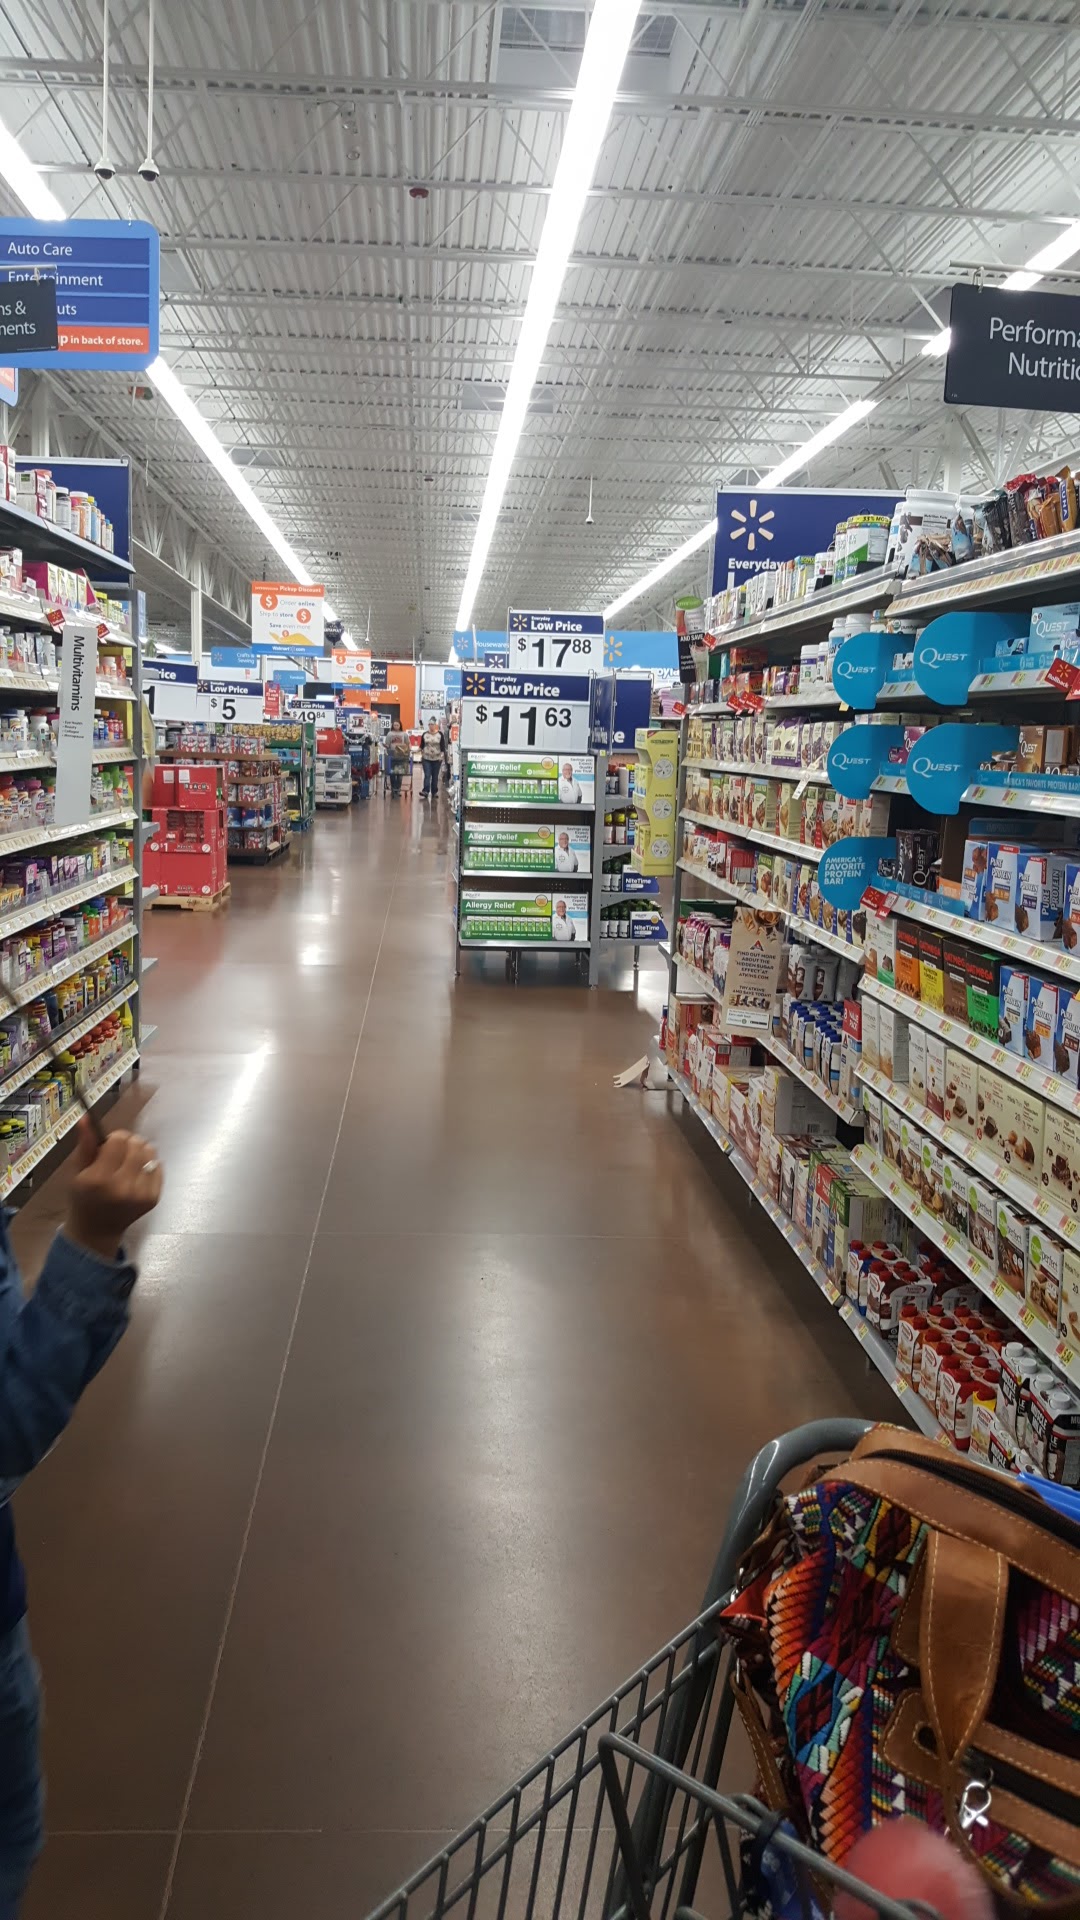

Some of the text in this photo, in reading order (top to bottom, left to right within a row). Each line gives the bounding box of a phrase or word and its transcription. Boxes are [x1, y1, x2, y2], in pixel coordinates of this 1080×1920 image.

[8, 242, 73, 256] Auto Care
[15, 300, 26, 315] &
[70, 335, 144, 346] in back of store.
[531, 621, 582, 632] Low Price
[1036, 620, 1070, 638] QUEST
[919, 647, 967, 668] QUEST
[71, 635, 85, 711] Multivitamins
[837, 661, 876, 679] QUEST
[490, 676, 517, 684] Everyday
[1047, 673, 1069, 688] Rollback
[210, 685, 248, 694] Low Price
[490, 682, 560, 697] Low Price
[471, 762, 498, 771] Allergy
[832, 753, 871, 770] QUEST
[912, 757, 960, 778] QUEST
[468, 833, 495, 841] Allergy
[825, 870, 861, 878] PROTEIN
[1051, 869, 1060, 910] PROTEIN
[465, 901, 492, 910] Allergy
[1042, 889, 1050, 915] PURE
